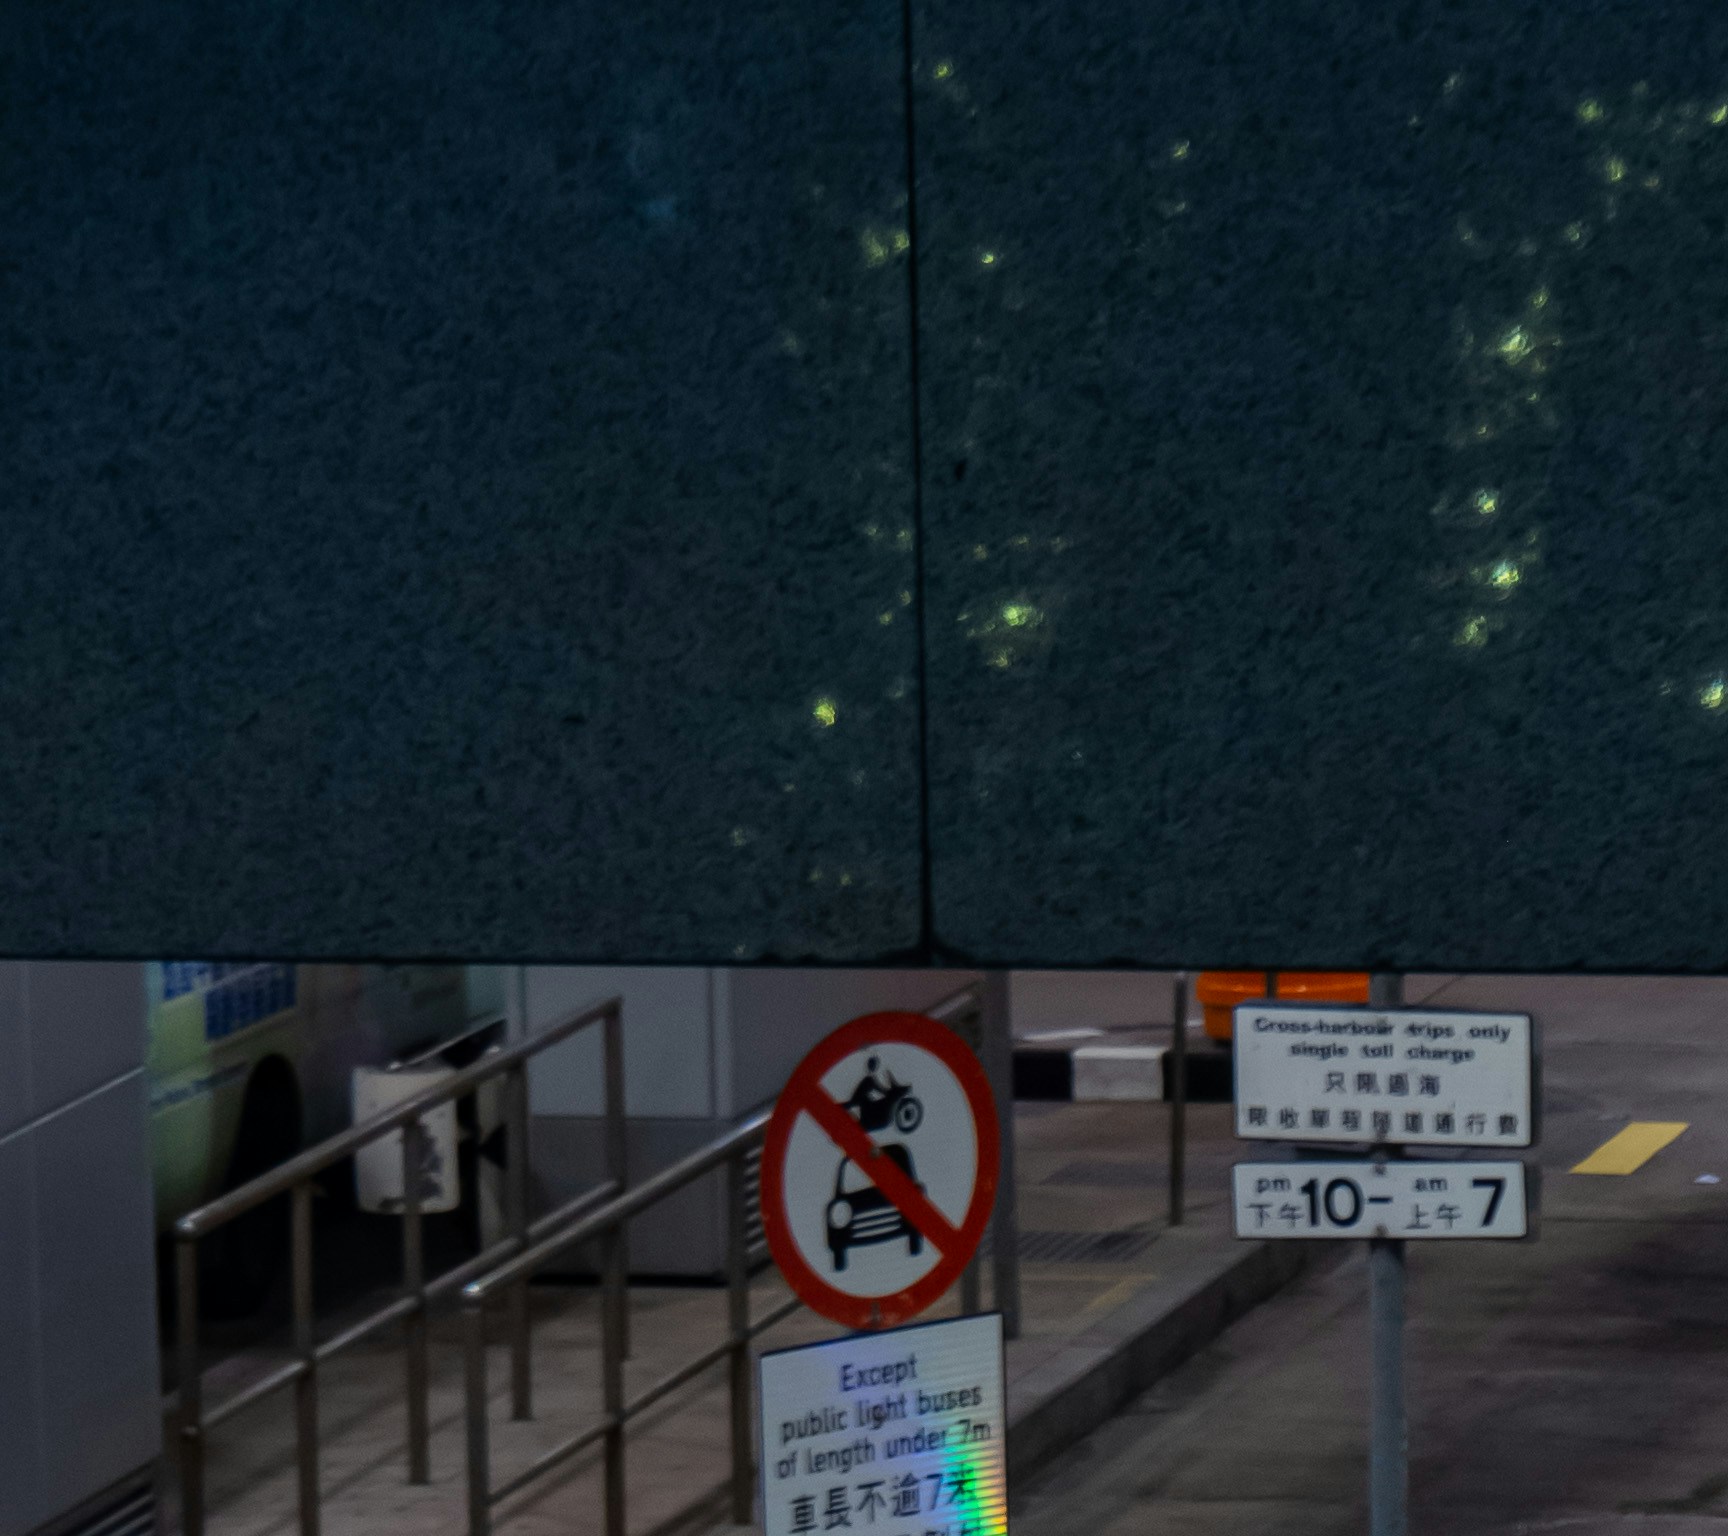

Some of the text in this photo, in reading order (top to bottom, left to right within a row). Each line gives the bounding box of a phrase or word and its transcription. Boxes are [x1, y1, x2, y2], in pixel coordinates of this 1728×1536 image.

[1254, 1017, 1511, 1043] Cross-harbour trips only
[1289, 1041, 1476, 1064] single toll charge
[1246, 1203, 1463, 1230] 下午 上午
[1255, 1178, 1291, 1193] pm
[1414, 1178, 1449, 1192] am
[1471, 1178, 1507, 1227] 7
[841, 1355, 917, 1392] Except
[782, 1385, 982, 1445] public light buses
[777, 1418, 992, 1479] of length under 7m
